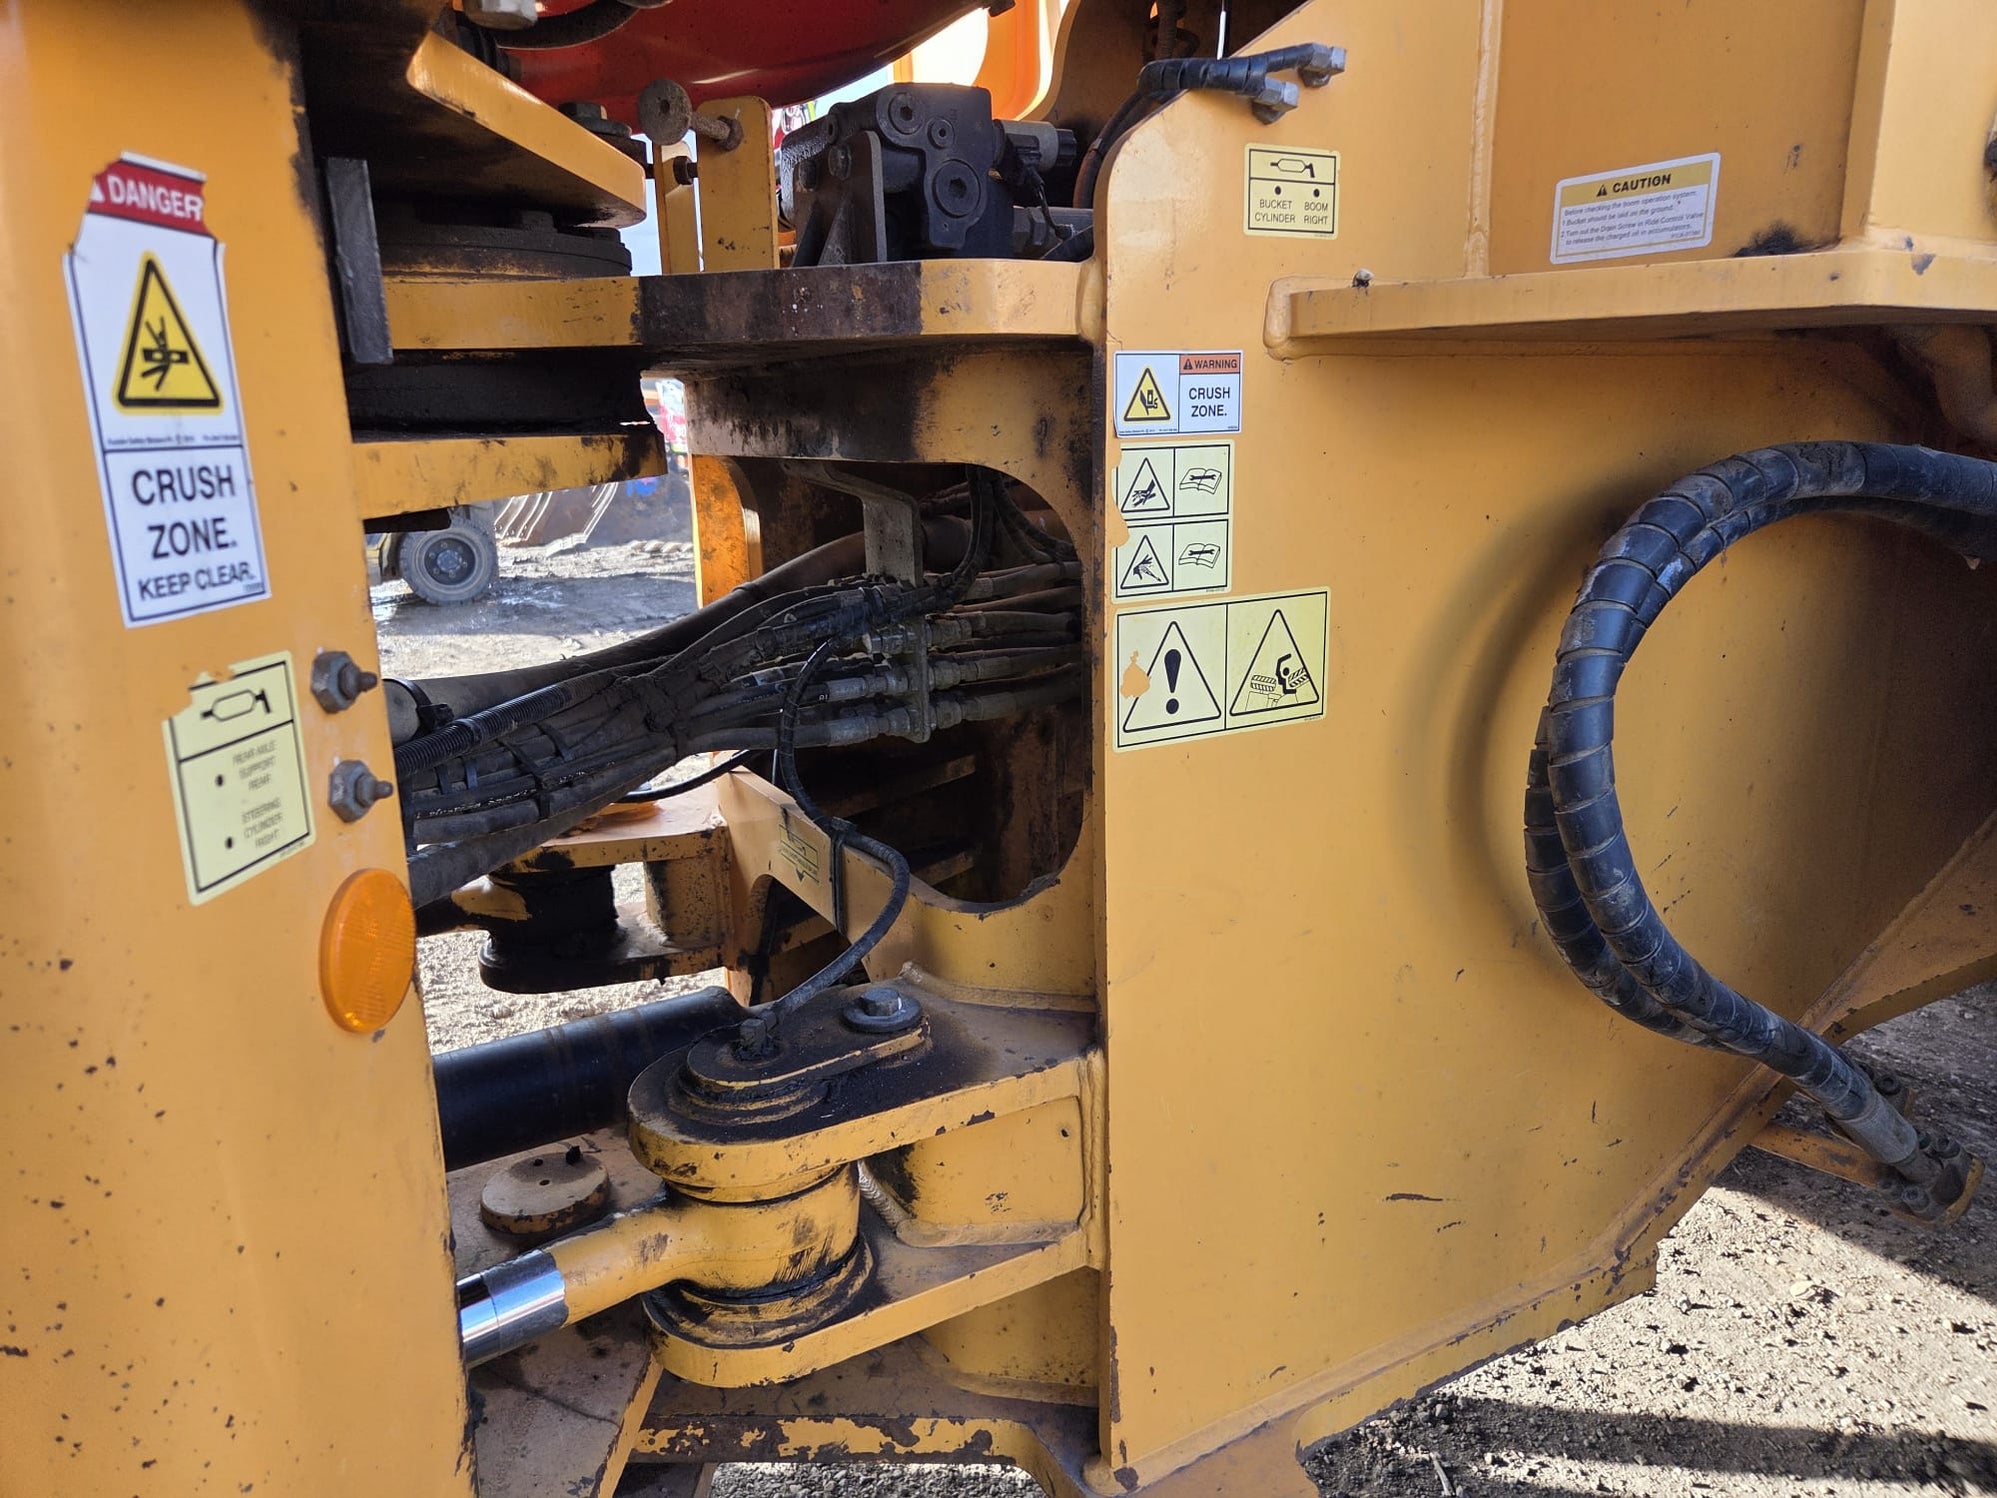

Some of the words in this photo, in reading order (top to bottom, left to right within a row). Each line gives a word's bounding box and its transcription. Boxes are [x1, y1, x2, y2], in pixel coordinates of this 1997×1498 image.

[1612, 174, 1671, 192] CAUTION
[107, 174, 204, 222] DANGER
[1259, 199, 1292, 209] BUCKET
[1304, 201, 1328, 211] BOOM
[1584, 204, 1610, 214] checking
[1254, 212, 1296, 223] CYLINDER
[1303, 215, 1328, 224] RIGHT
[1606, 231, 1630, 241] charged
[1195, 359, 1238, 369] WARNING
[1188, 386, 1231, 400] CRUSH
[1191, 404, 1227, 418] ZONE.
[132, 464, 236, 506] CRUSH
[147, 517, 237, 560] ZONE.
[138, 572, 191, 600] KEEP
[194, 561, 255, 591] CLEAR.
